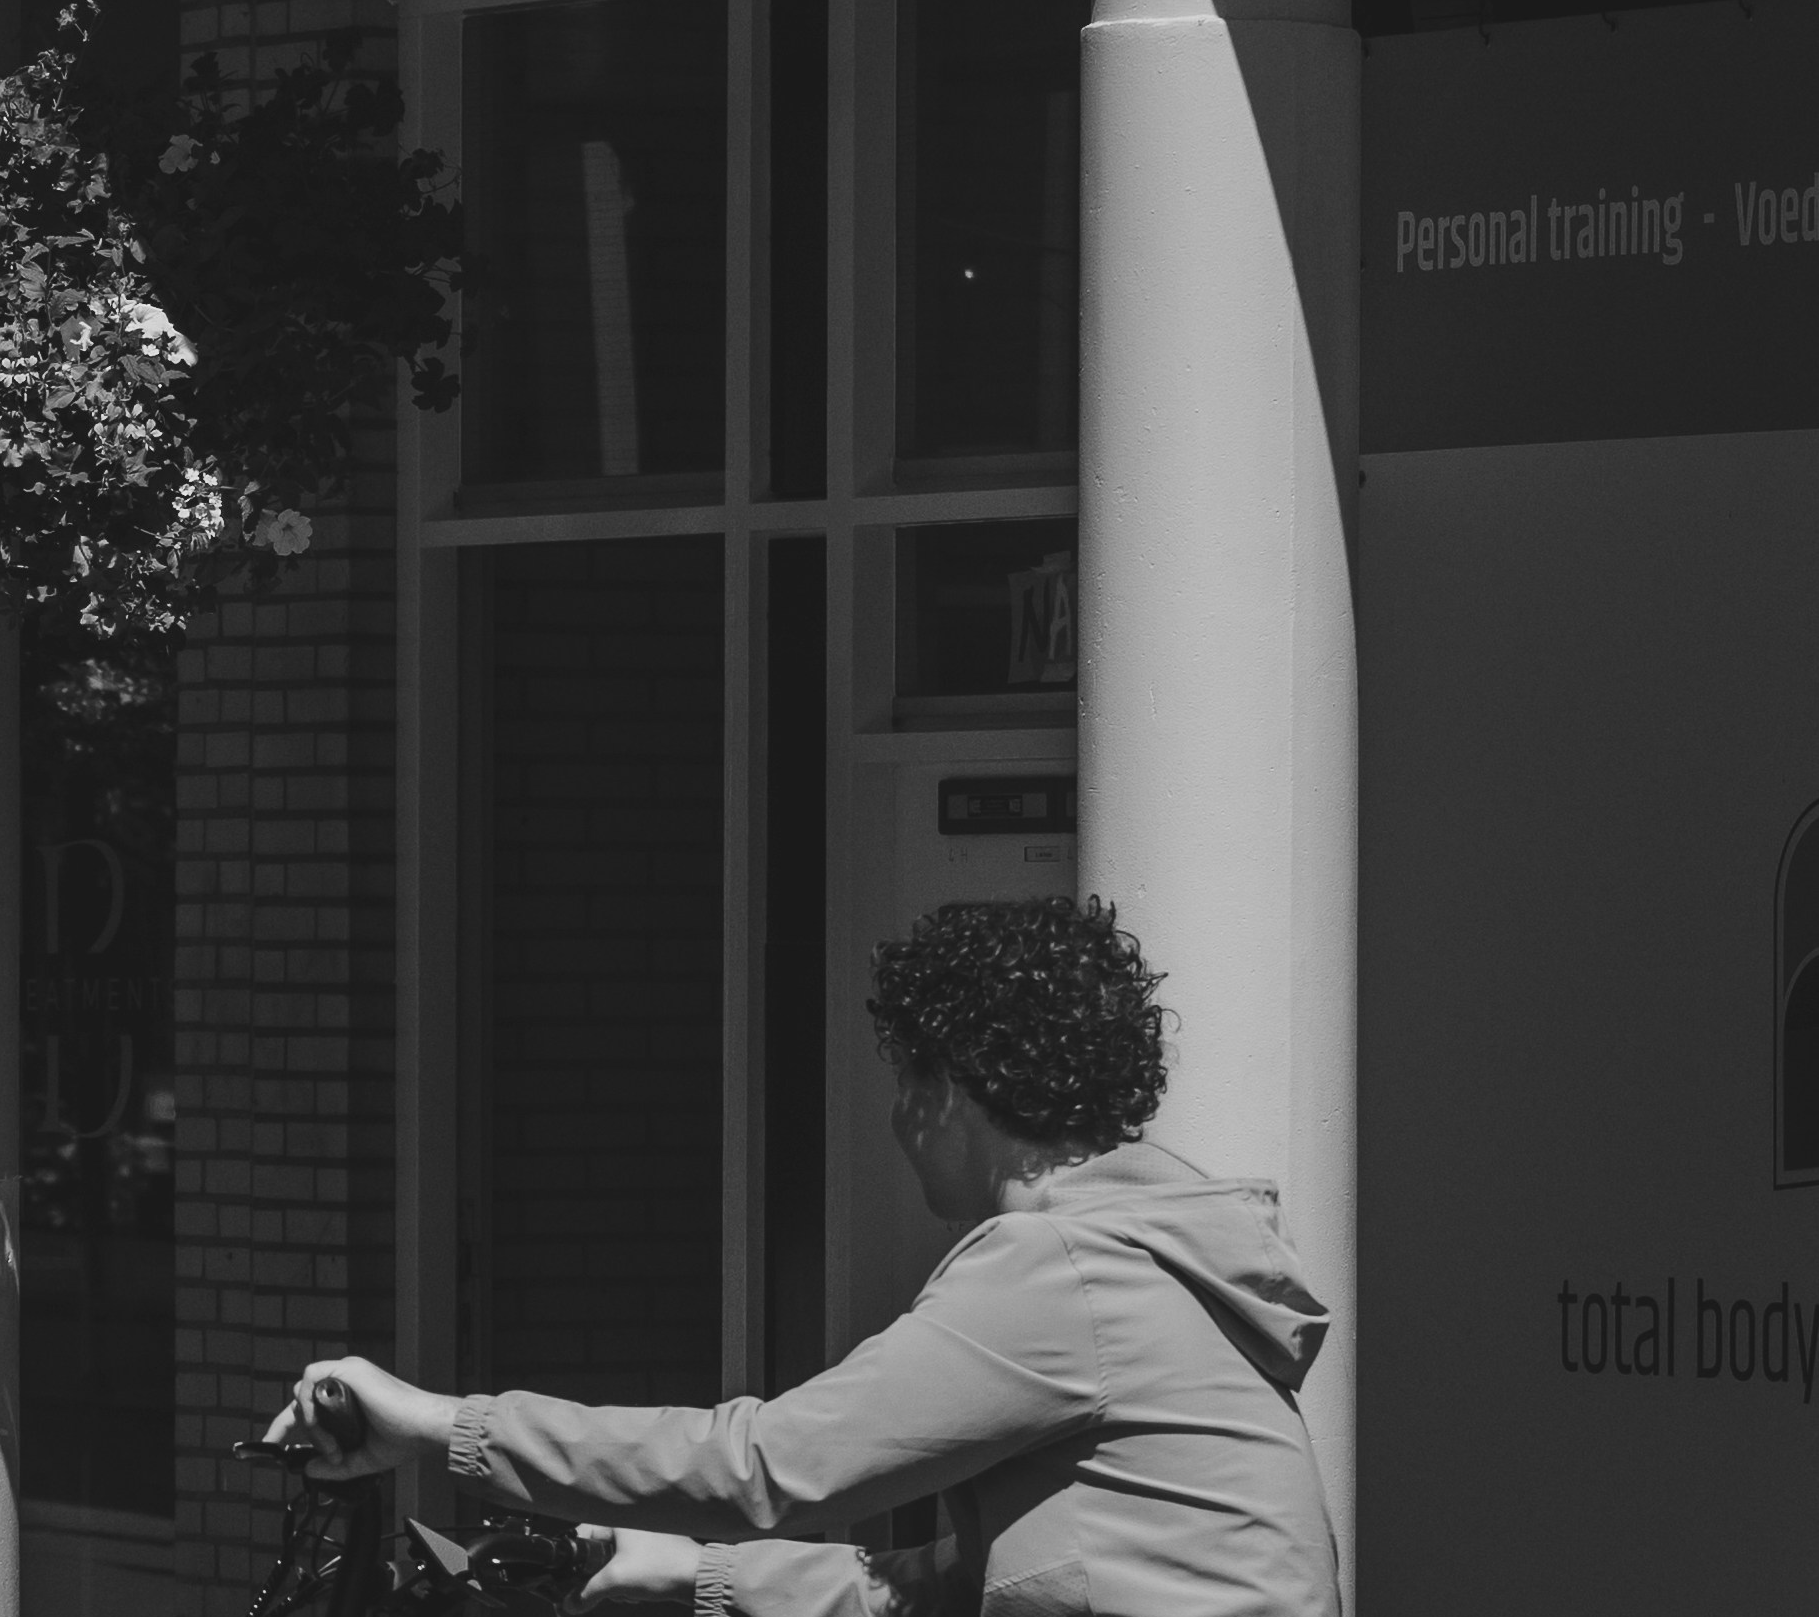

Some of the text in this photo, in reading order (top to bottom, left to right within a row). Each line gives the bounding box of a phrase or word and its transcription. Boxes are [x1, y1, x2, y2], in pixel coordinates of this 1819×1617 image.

[1397, 195, 1538, 273] Personal
[1548, 185, 1684, 266] training
[1735, 172, 1819, 247] Voed
[1557, 1276, 1819, 1405] total body
